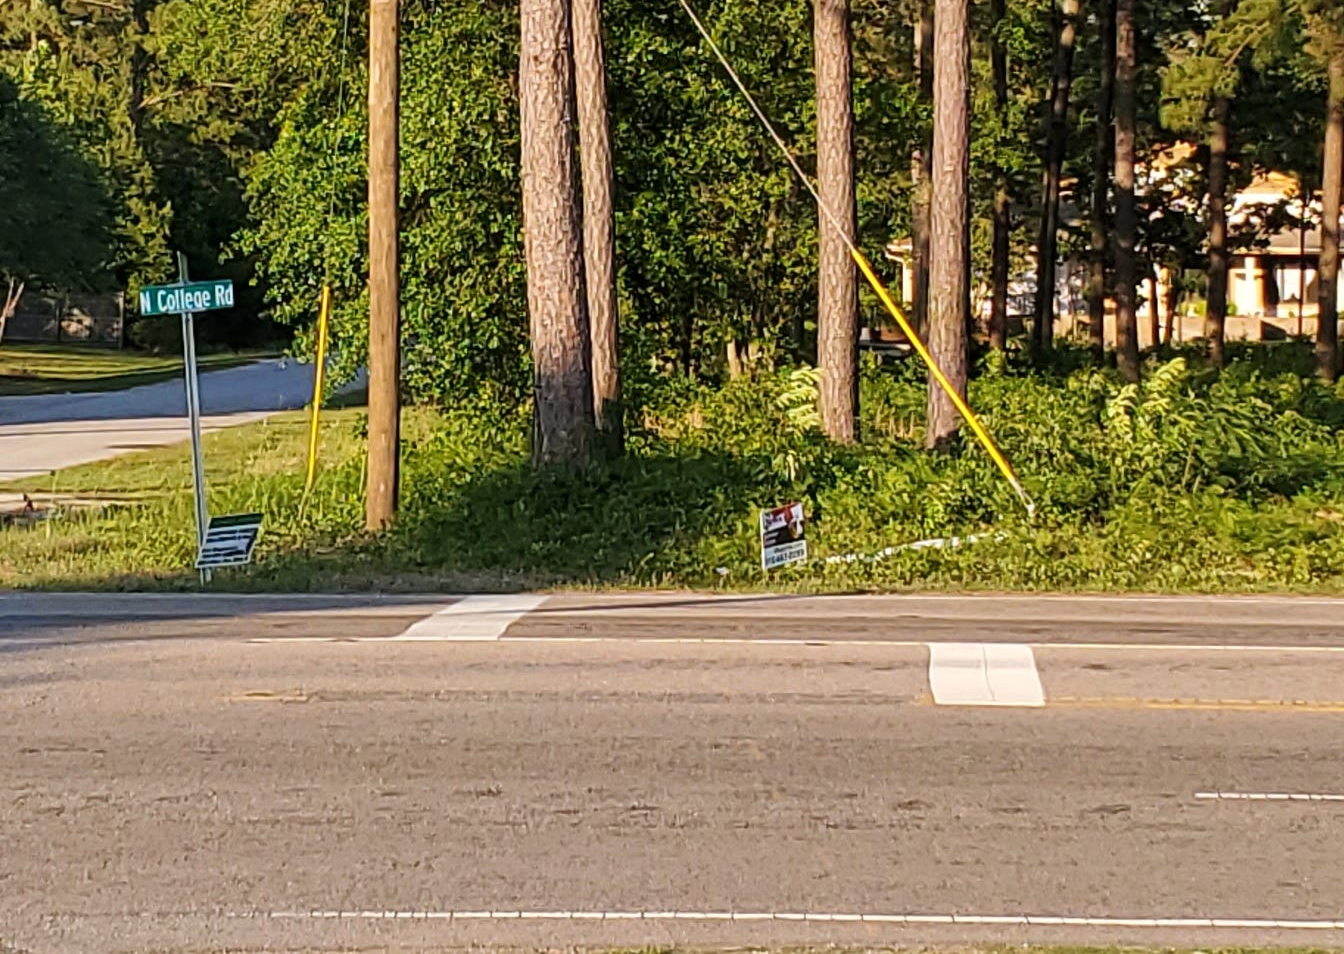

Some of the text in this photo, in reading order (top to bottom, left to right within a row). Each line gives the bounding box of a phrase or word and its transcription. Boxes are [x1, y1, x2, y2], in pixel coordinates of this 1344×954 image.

[140, 283, 233, 313] N College Rd
